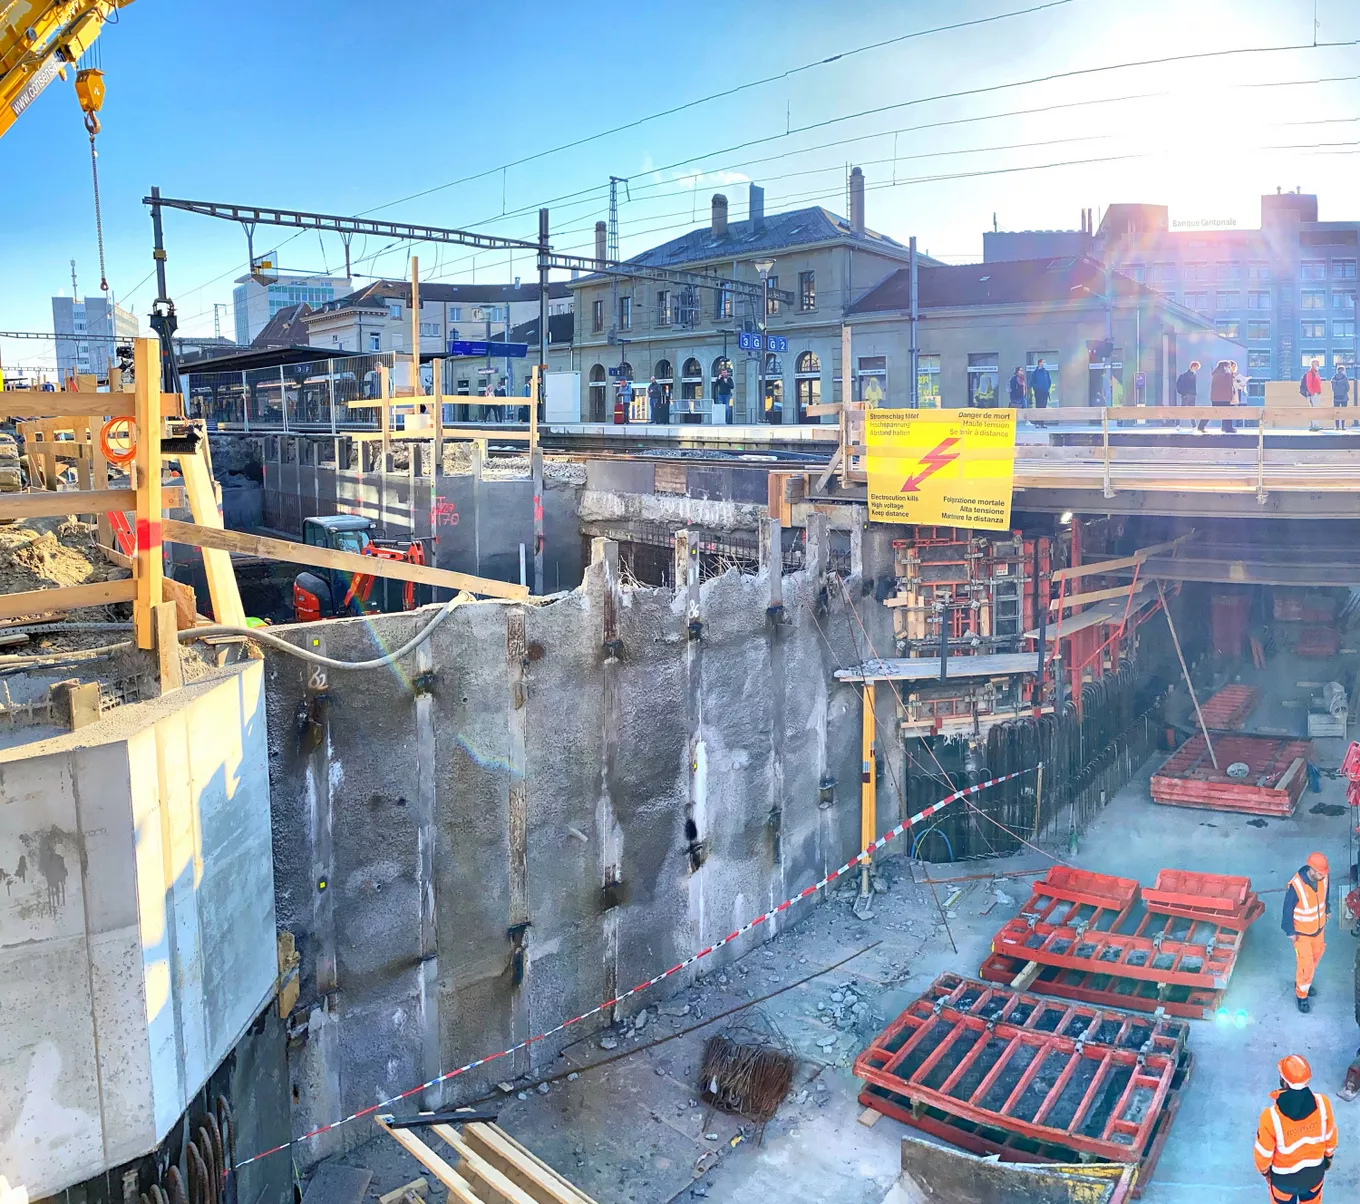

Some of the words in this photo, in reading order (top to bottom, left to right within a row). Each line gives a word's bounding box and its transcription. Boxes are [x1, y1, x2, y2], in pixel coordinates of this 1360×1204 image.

[1173, 219, 1200, 228] Banque
[743, 337, 749, 346] 3
[754, 338, 760, 347] G
[770, 340, 776, 349] G
[780, 342, 785, 350] 2
[688, 599, 700, 618] 86
